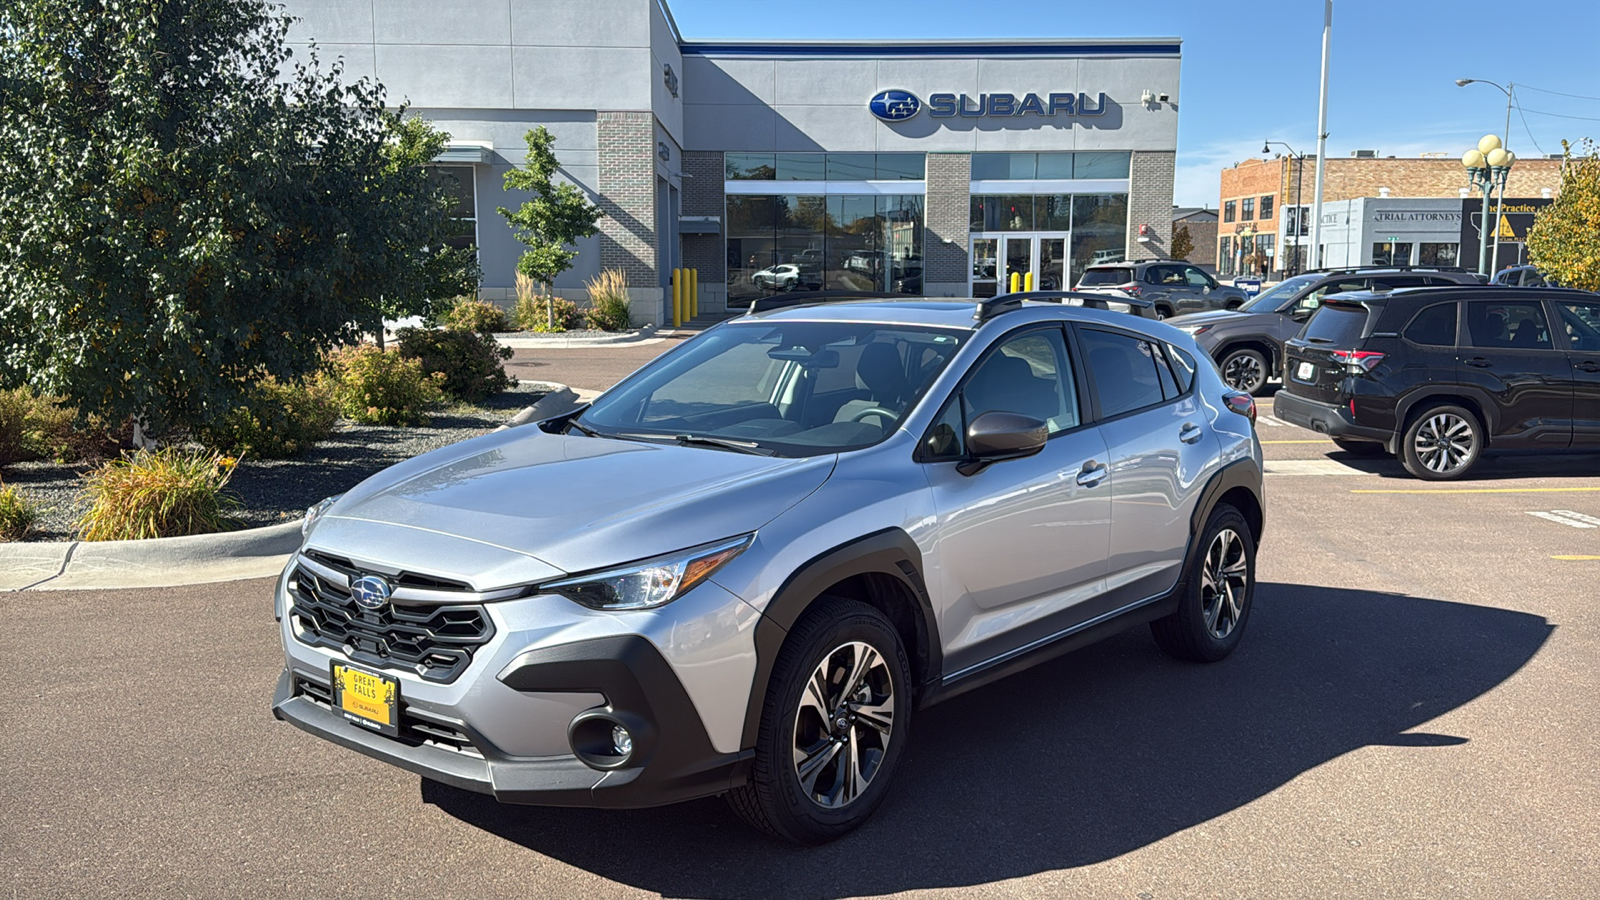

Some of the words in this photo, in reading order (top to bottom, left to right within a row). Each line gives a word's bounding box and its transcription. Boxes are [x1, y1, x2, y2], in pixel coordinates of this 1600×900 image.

[929, 93, 1106, 117] SUBARU
[1500, 203, 1536, 212] Practice
[1378, 213, 1406, 221] TRIAL
[1408, 213, 1461, 221] ATTORNEYS
[353, 674, 375, 688] GREAT
[354, 684, 376, 699] FALLS
[358, 703, 379, 715] SUBARU
